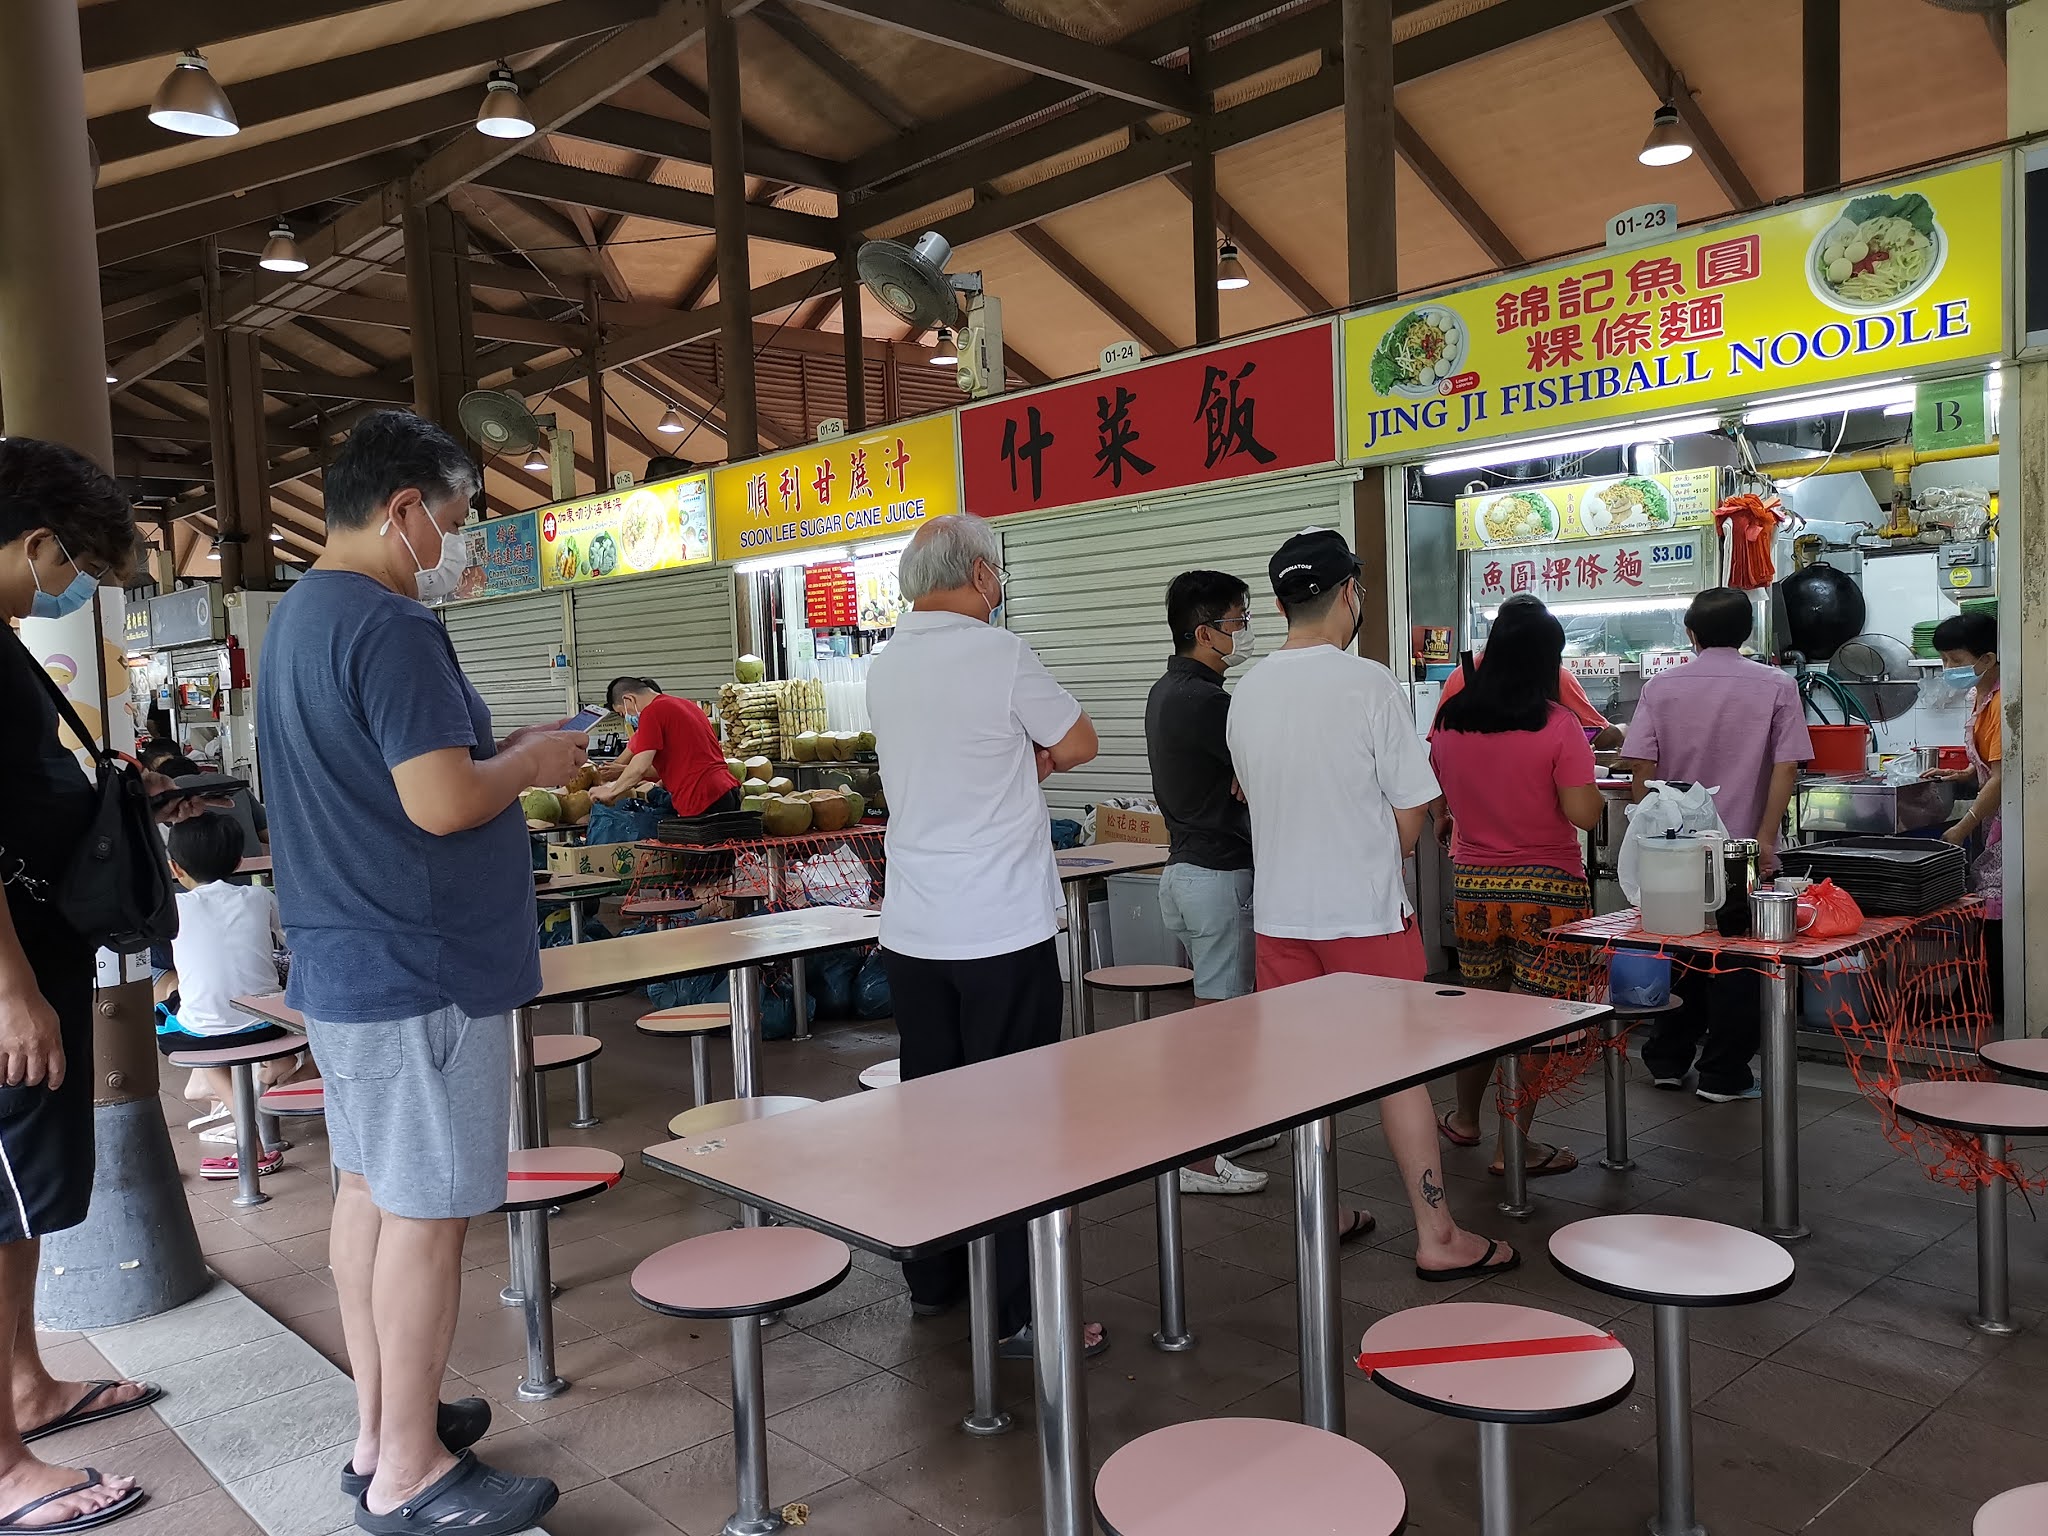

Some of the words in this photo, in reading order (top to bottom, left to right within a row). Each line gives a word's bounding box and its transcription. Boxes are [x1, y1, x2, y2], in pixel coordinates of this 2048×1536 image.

[1615, 208, 1667, 237] 01-23
[1495, 233, 1761, 335] 錦記魚圓
[1526, 293, 1724, 373] 粿條麵
[1104, 344, 1134, 364] 01-24
[1364, 398, 1449, 449] JING
[1456, 390, 1488, 433] JI
[1500, 350, 1712, 416] FISHBALL
[1728, 298, 1971, 376] NOODLE
[819, 421, 841, 437] 01-25
[1934, 399, 1964, 434] B
[1001, 361, 1278, 502] 什菜飯
[616, 473, 632, 486] 01-26
[746, 437, 911, 521] 順利甘蔗汁
[740, 527, 773, 549] SOON
[775, 522, 797, 544] LEE
[800, 514, 843, 538] SUGAR
[845, 507, 882, 531] CANE
[885, 499, 926, 525] JUICE
[1652, 544, 1693, 563] $3.00
[488, 568, 508, 580] Changi
[508, 563, 530, 578] Village
[500, 577, 523, 588] Hokkien
[522, 574, 536, 585] Mee
[1480, 548, 1644, 596] 魚圓粿條麵
[1571, 667, 1616, 676] -SERVICE
[1107, 814, 1150, 833] 松花皮蛋
